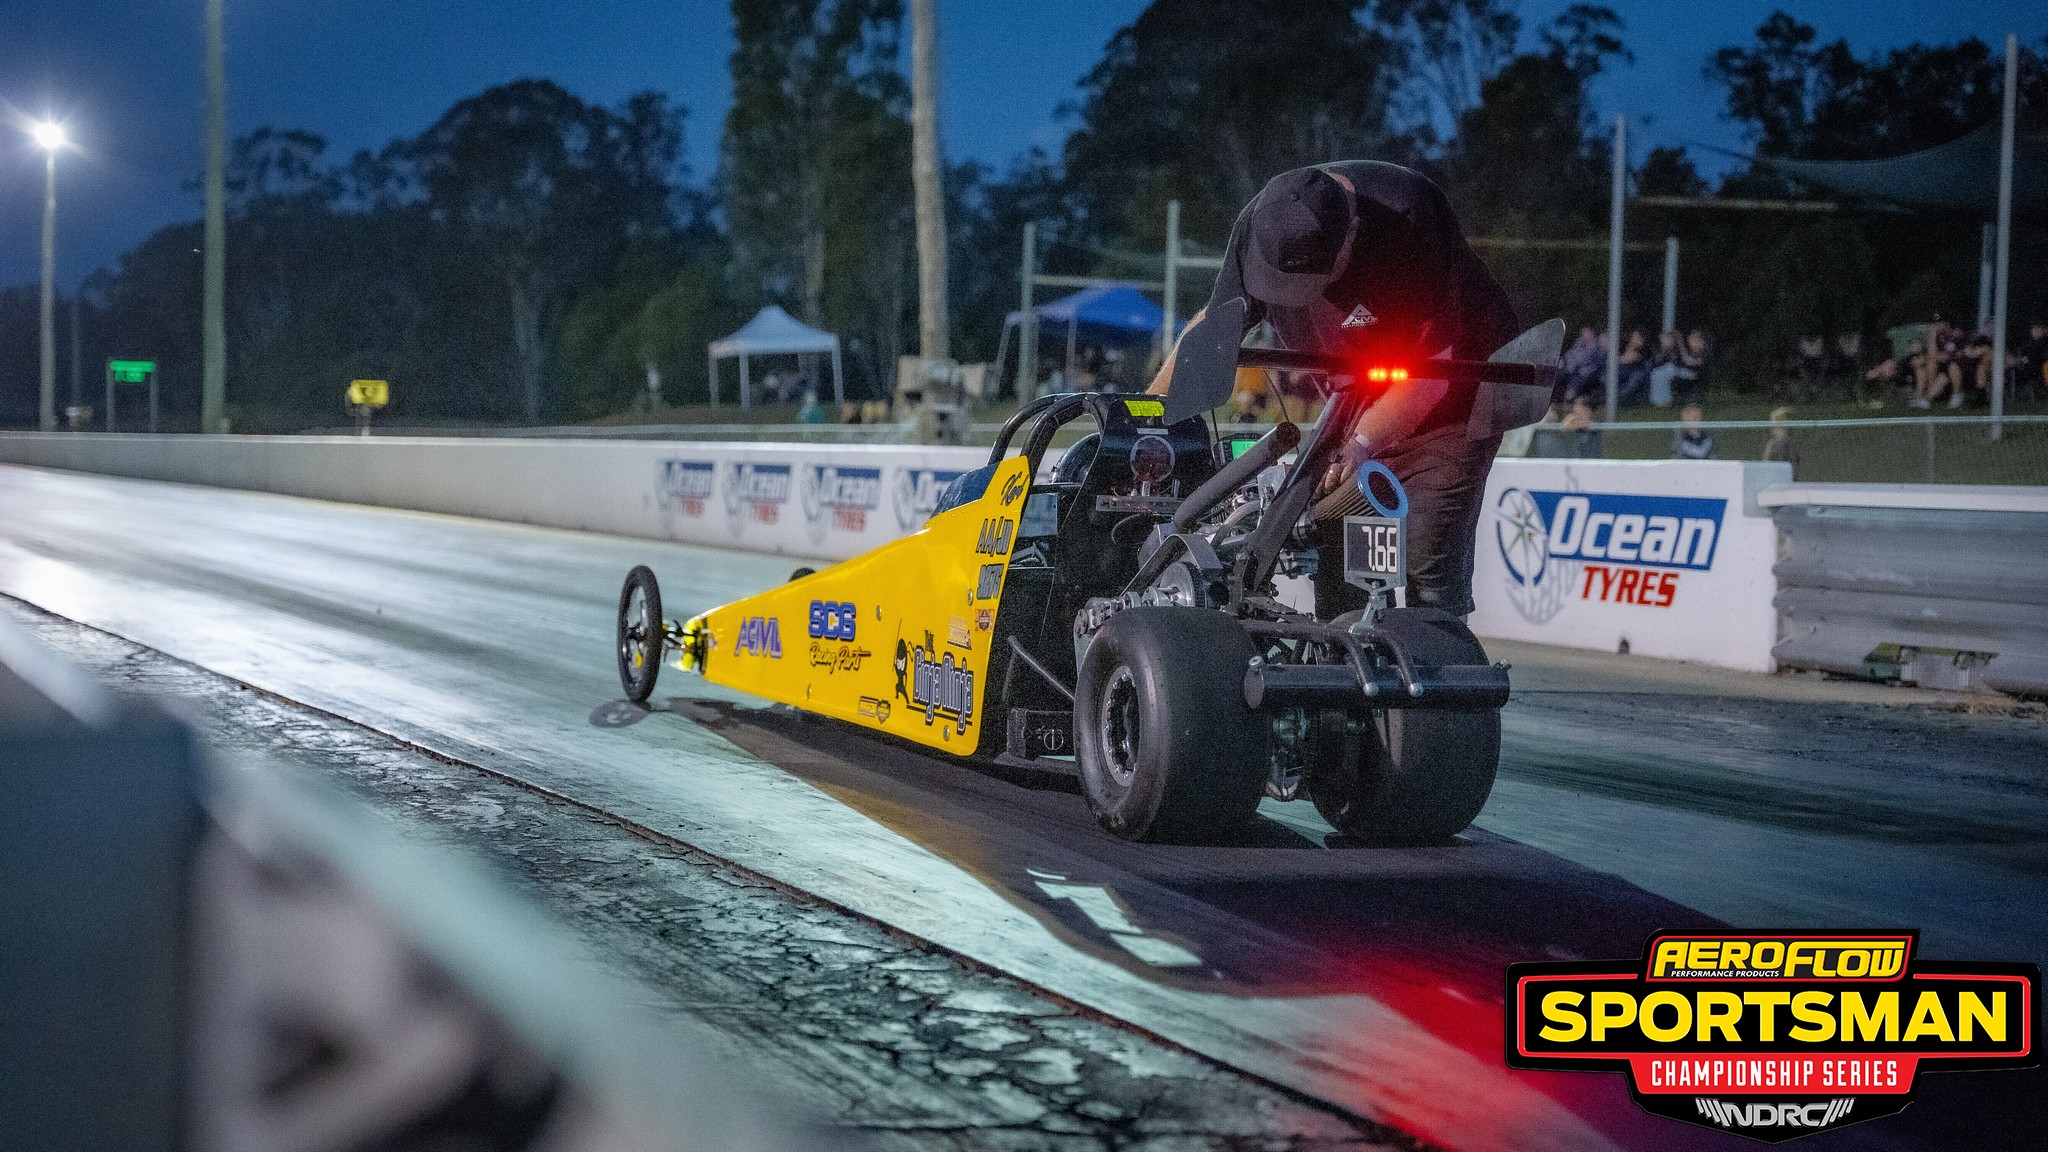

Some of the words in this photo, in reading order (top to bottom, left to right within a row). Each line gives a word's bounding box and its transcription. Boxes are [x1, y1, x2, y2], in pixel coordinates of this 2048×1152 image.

[1361, 526, 1397, 573] 7.66
[1550, 496, 1716, 566] Ocean
[1582, 566, 1679, 608] TYRES
